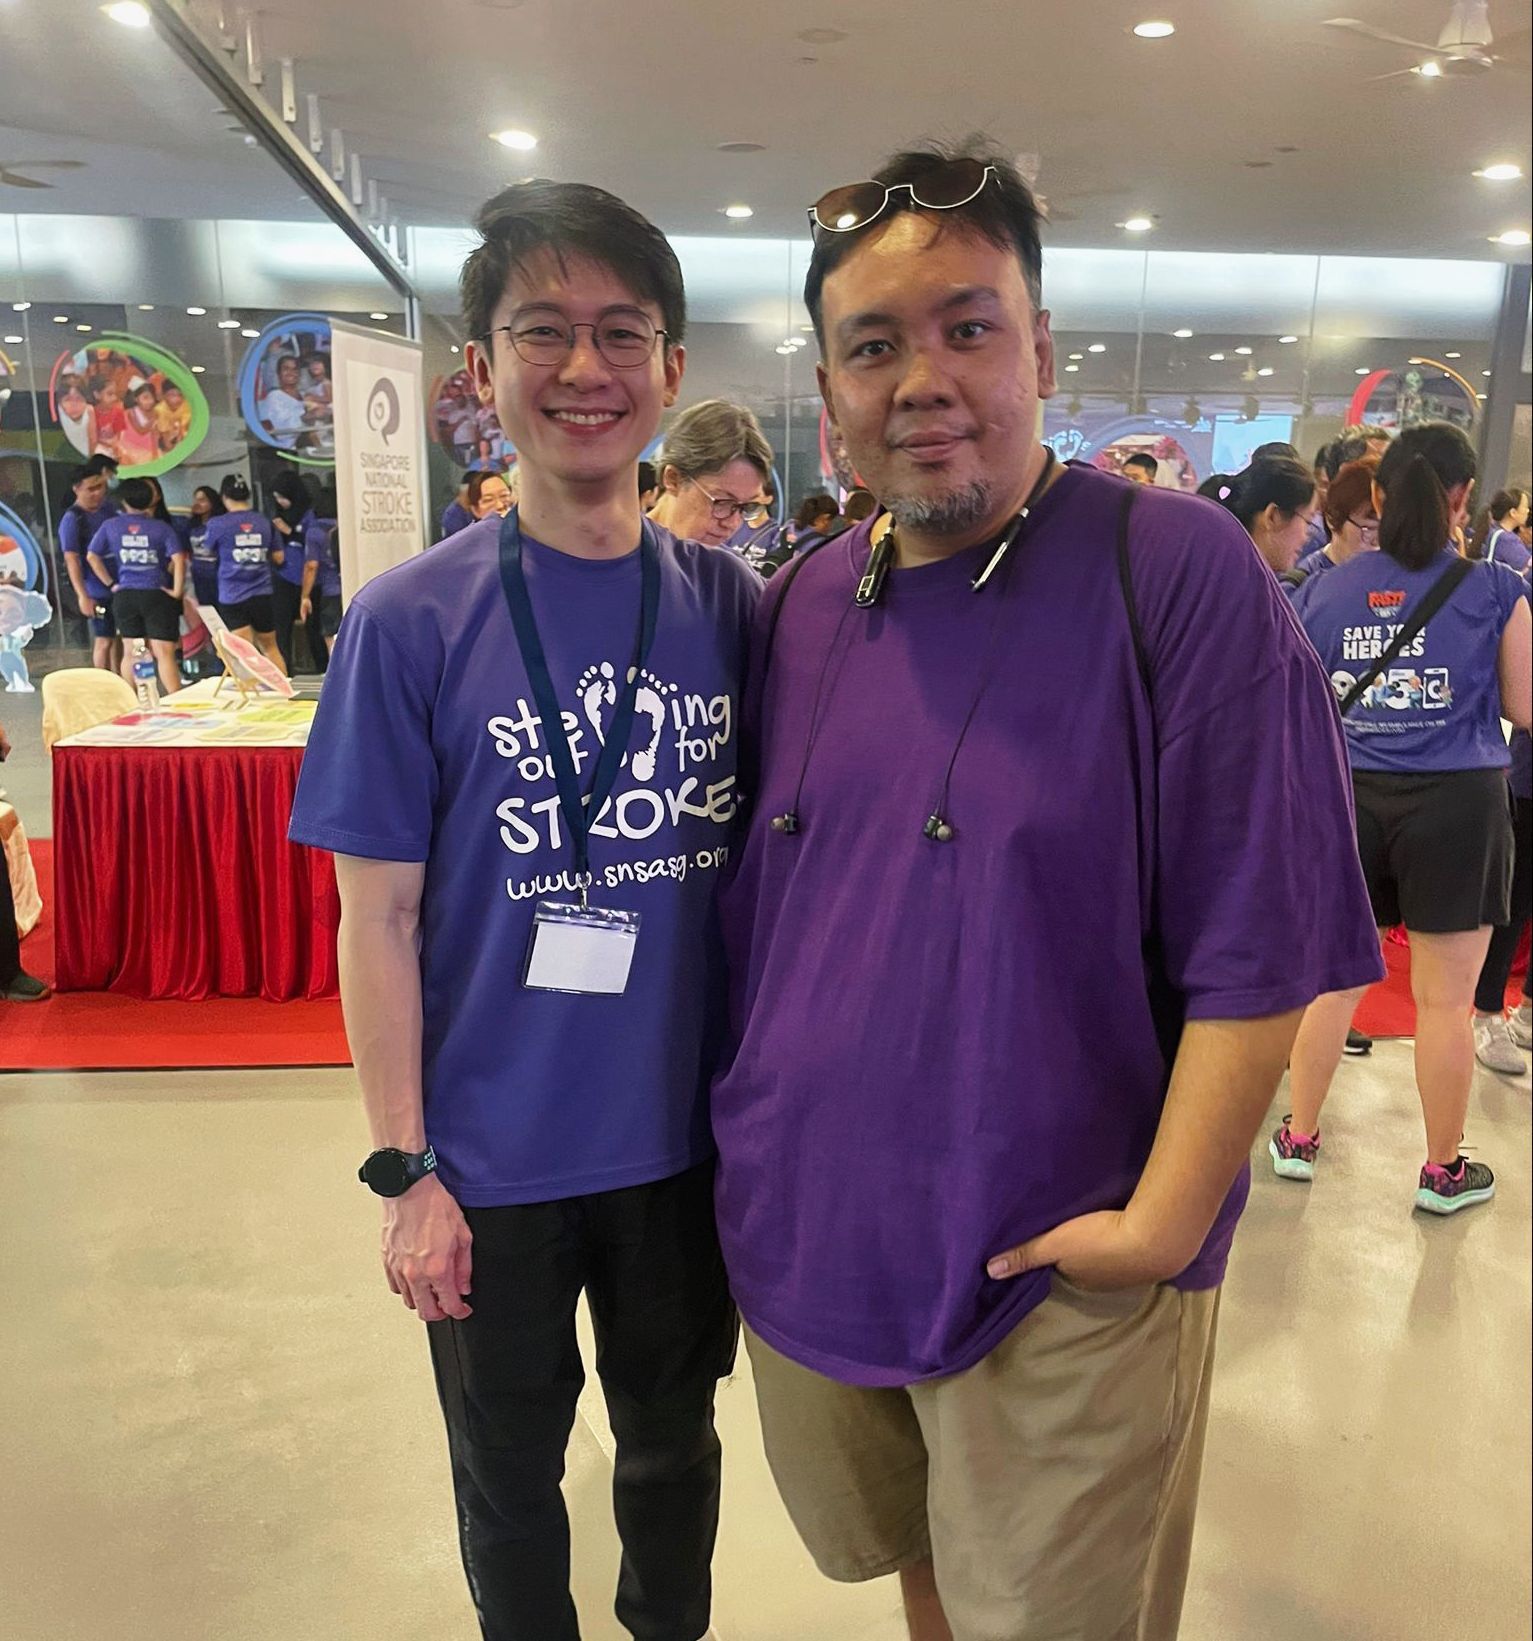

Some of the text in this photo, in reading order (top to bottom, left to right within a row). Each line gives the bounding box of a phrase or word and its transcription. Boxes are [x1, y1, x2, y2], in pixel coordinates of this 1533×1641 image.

[360, 451, 410, 471] SINGAPORE
[365, 472, 407, 489] NATIONAL
[362, 491, 413, 515] STROKE
[360, 518, 416, 534] ASSOCIATION
[1343, 625, 1382, 641] SAVE
[675, 725, 724, 773] for
